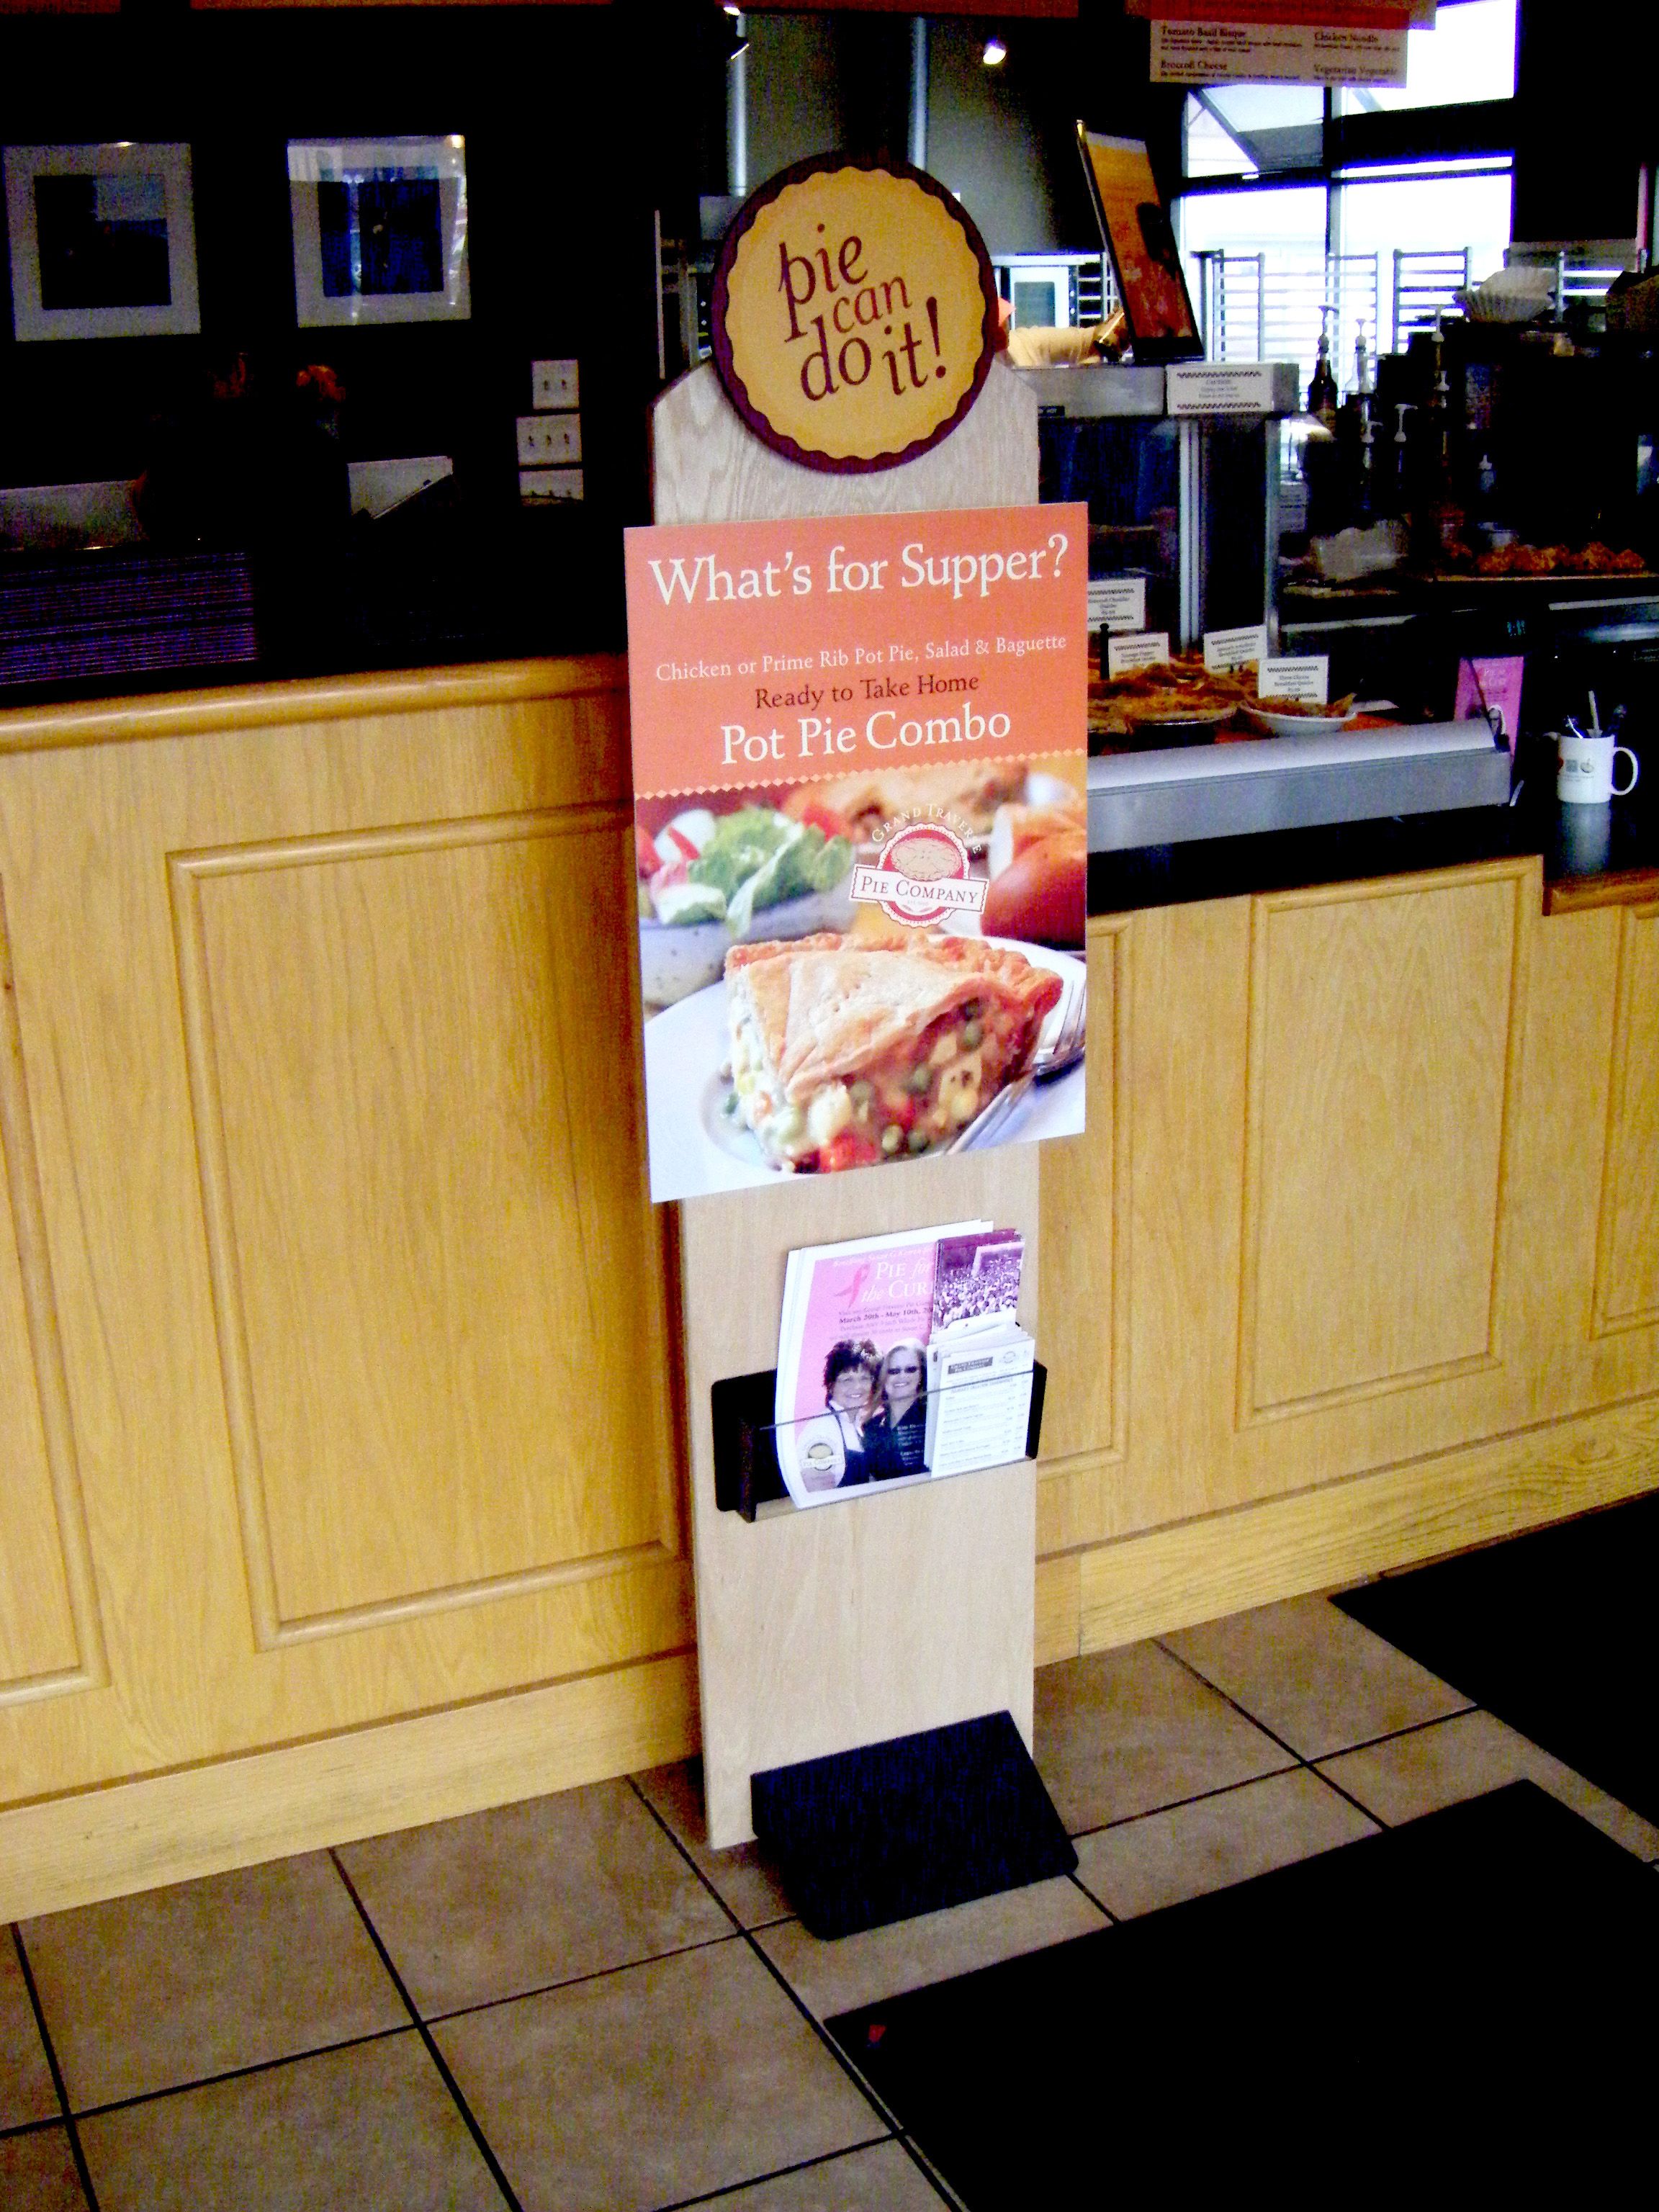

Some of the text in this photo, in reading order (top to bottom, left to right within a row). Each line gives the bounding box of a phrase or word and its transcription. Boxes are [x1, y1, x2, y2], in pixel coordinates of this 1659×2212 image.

[778, 223, 868, 343] pie
[833, 276, 912, 333] can
[801, 296, 946, 401] do it!
[647, 534, 1069, 605] What's for Supper?
[656, 635, 1066, 681] Chicken or Prime Rib Pot Pie, Salad & Baguette
[755, 674, 979, 711] Ready to Take Home
[721, 701, 1011, 765] Pot Pie Combo
[871, 803, 983, 855] GRAND TRAVERE
[860, 876, 979, 904] PIE COMPANY
[861, 1285, 884, 1303] the
[876, 1262, 907, 1280] PIE
[885, 1310, 901, 1319] May
